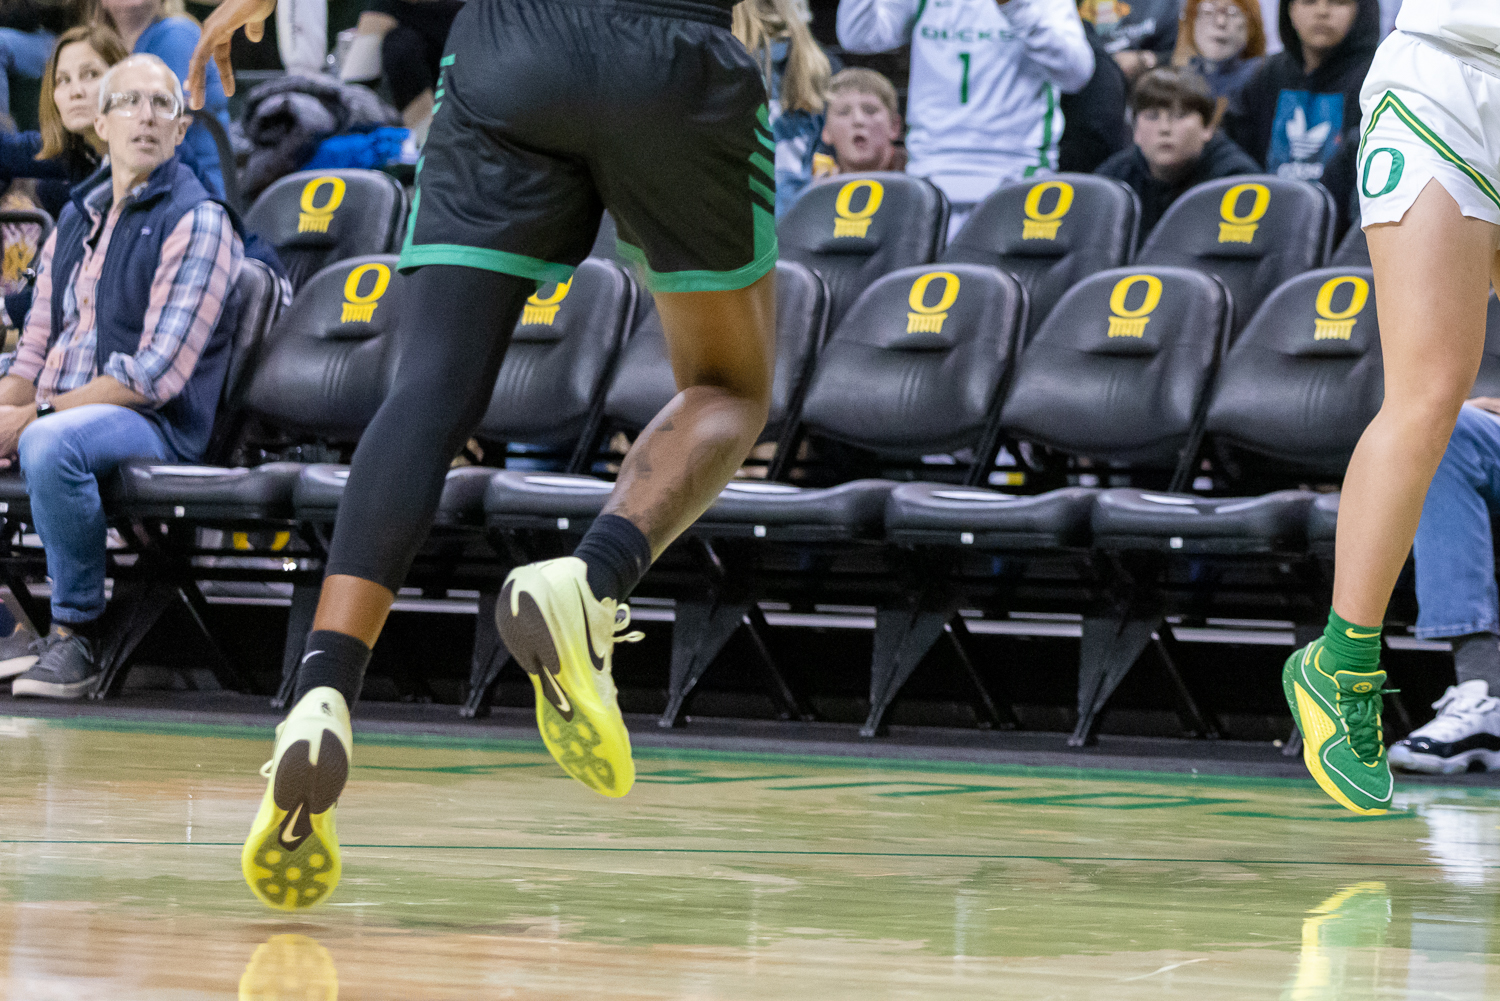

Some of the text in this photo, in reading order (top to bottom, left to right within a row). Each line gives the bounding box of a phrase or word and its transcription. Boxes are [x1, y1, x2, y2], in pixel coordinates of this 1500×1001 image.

[958, 52, 970, 103] 1
[1362, 147, 1405, 198] O
[300, 178, 346, 214] O
[837, 180, 884, 218] O
[1025, 182, 1074, 220] O
[1220, 183, 1270, 222] O
[343, 263, 391, 305] O
[908, 272, 960, 314] O
[1110, 275, 1163, 318] O
[1316, 276, 1369, 320] O
